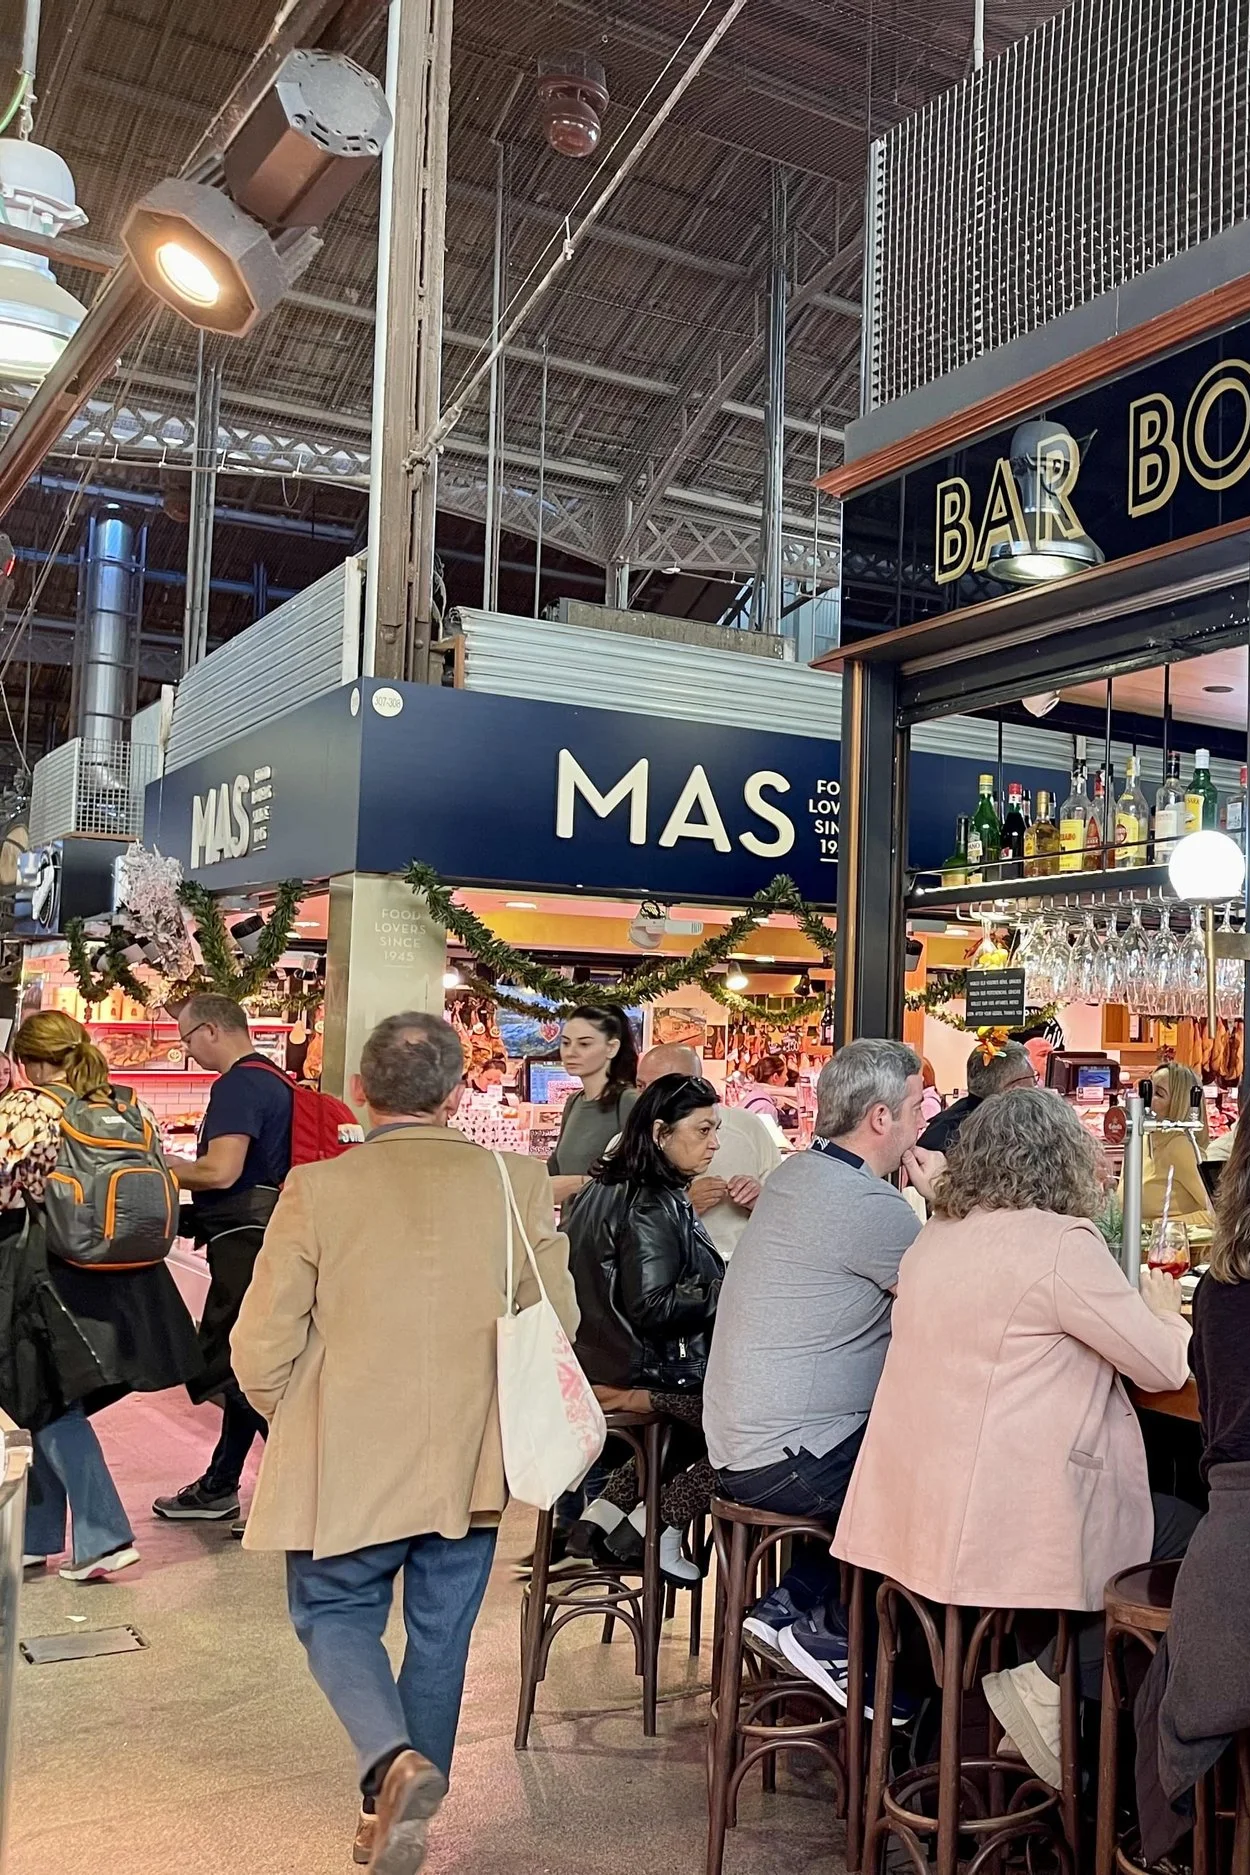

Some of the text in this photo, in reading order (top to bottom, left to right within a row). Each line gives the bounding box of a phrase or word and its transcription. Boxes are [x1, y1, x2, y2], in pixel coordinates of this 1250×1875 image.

[935, 431, 1084, 583] BAR
[555, 748, 796, 858] MAS
[190, 774, 250, 870] MAS
[382, 908, 421, 920] FOOD
[374, 922, 427, 935] LOVERS
[380, 936, 421, 949] SINCE
[384, 950, 415, 962] 1945
